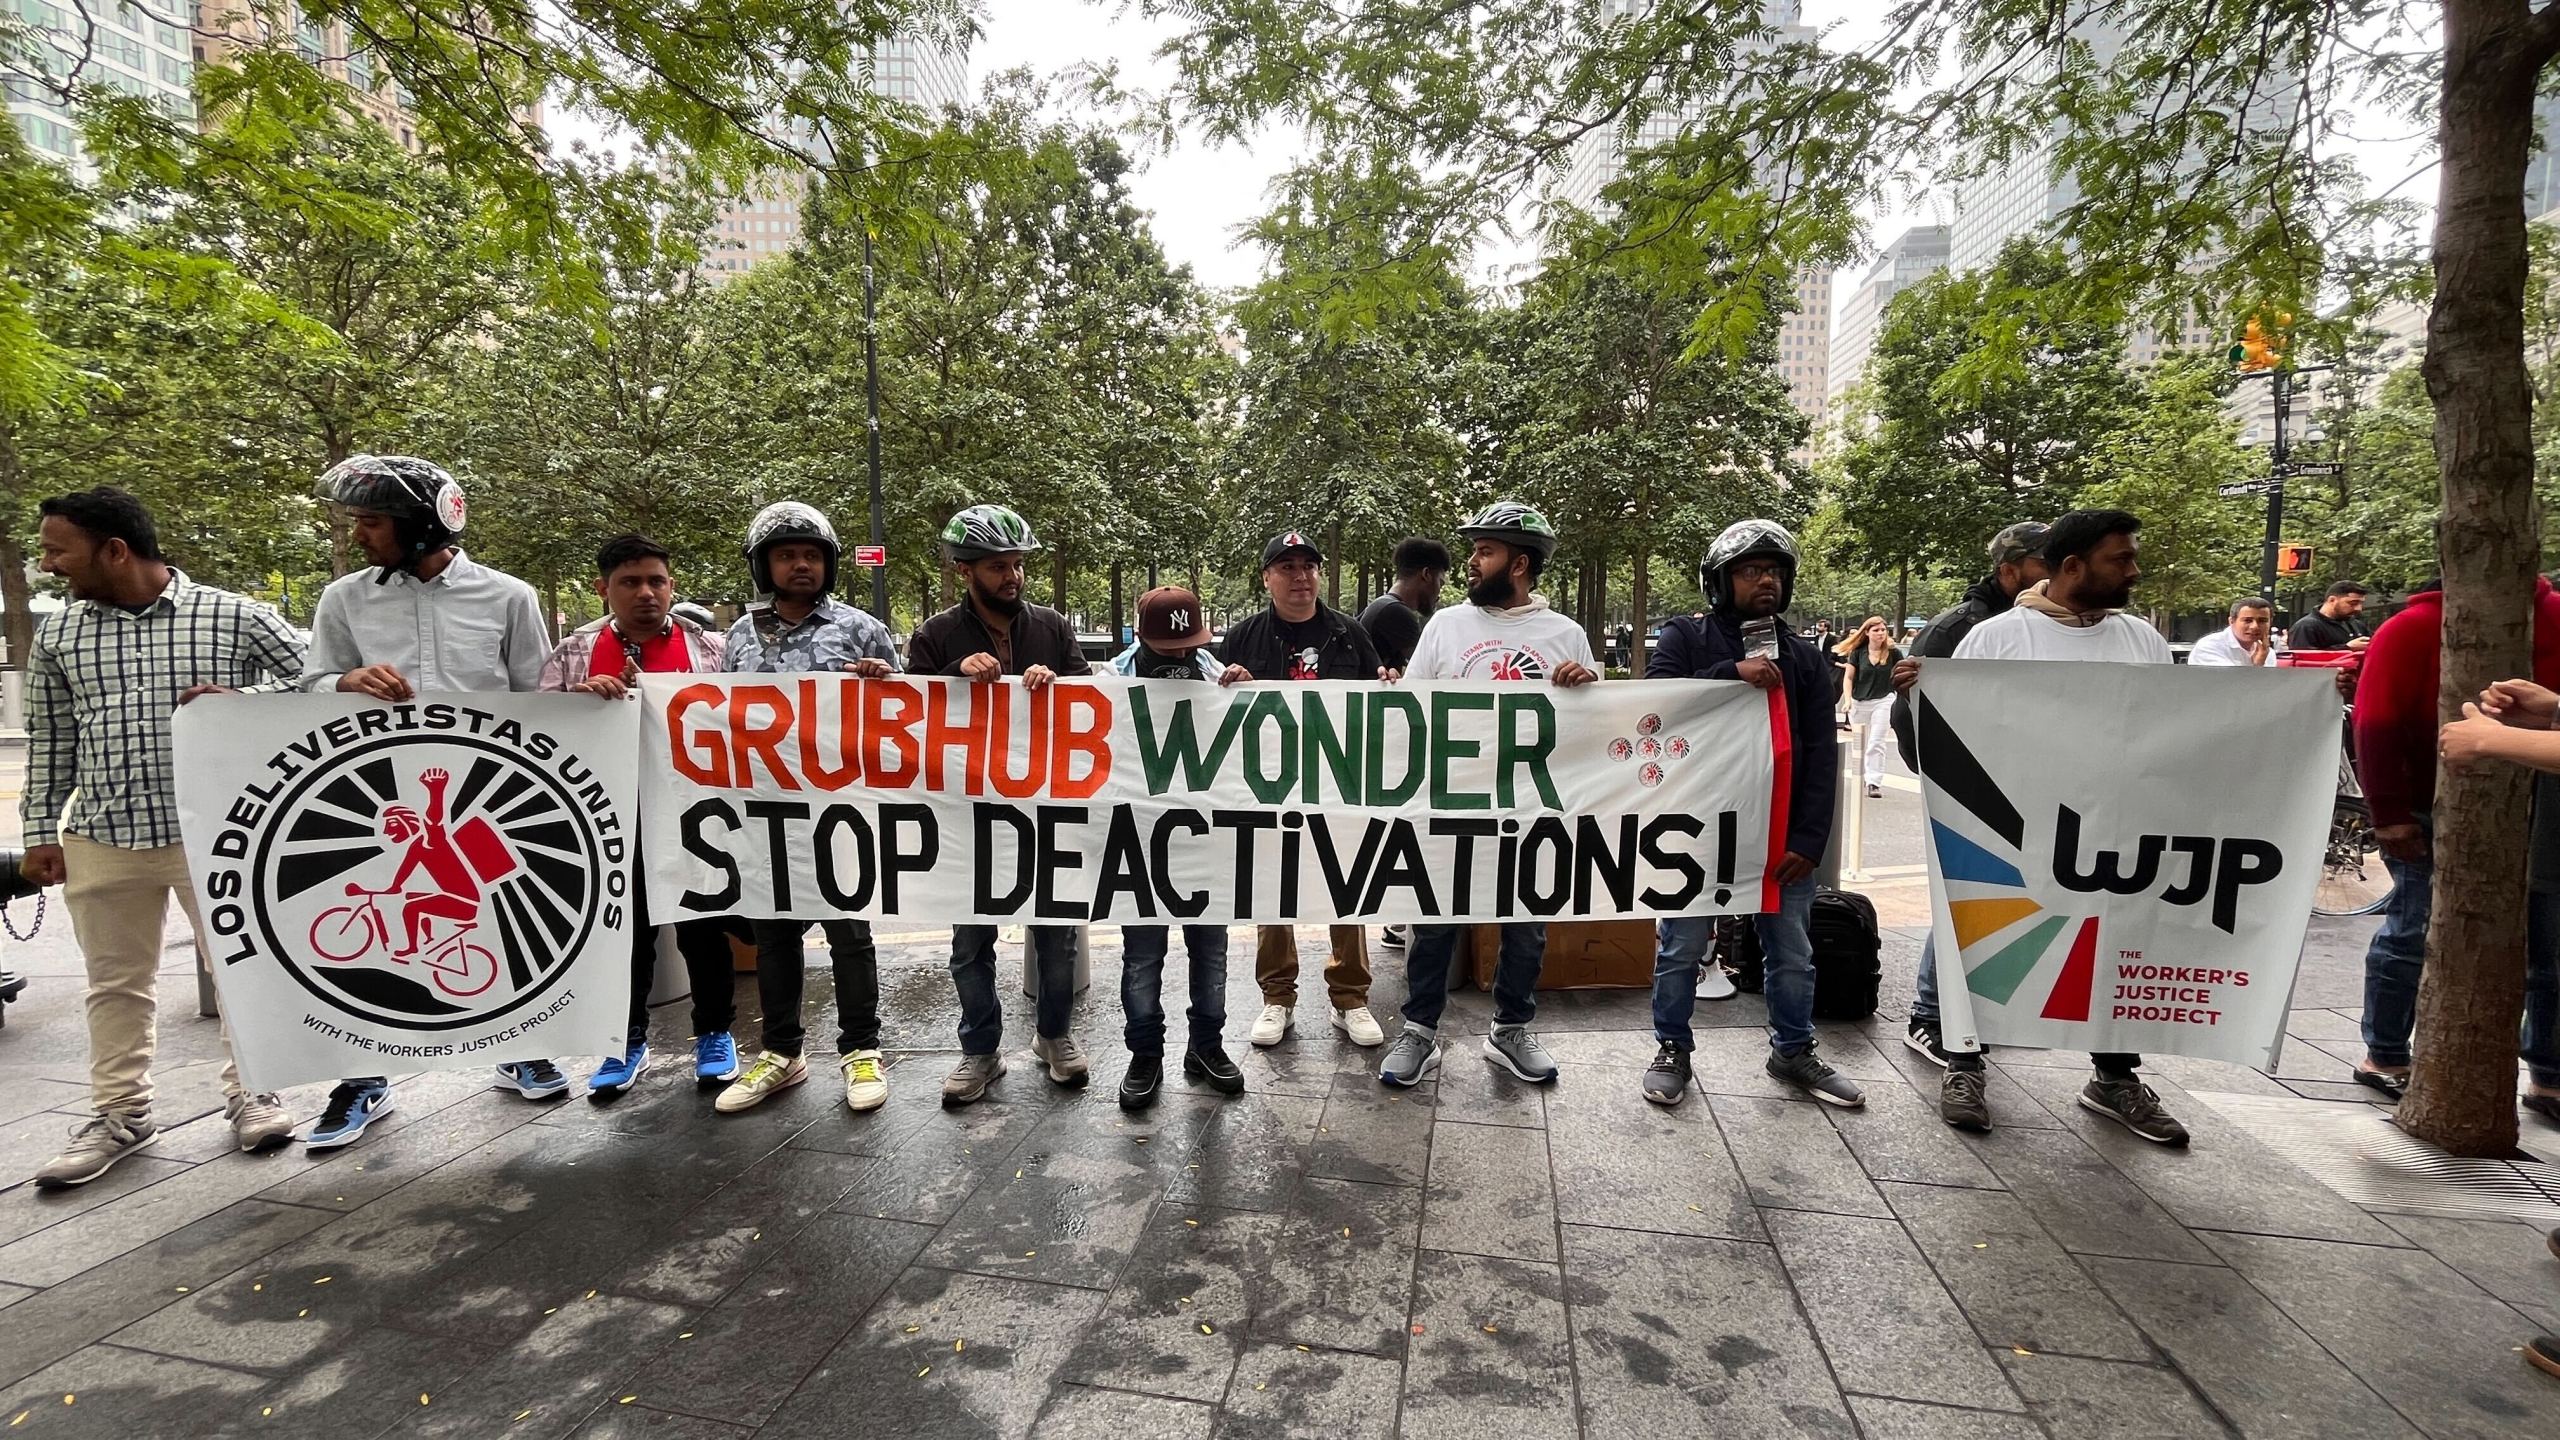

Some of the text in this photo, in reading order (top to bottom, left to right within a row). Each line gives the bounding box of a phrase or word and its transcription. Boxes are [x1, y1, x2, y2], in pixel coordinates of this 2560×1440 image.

[1169, 608, 1190, 632] NY
[1464, 643, 1484, 659] STAND
[1485, 639, 1503, 649] WITH
[1521, 644, 1549, 670] TO APOYO
[667, 679, 1564, 811] GRUBHUB WONDER
[207, 703, 626, 967] LOS DELIVERISTAS UNIDOS
[678, 797, 940, 916] STOP
[2052, 803, 2283, 935] WJP
[2119, 950, 2142, 959] THE
[2117, 964, 2249, 987] WORKER'S
[2113, 985, 2211, 1004] JUSTICE
[302, 989, 576, 1058] WITH THE WORKERS JUSTICE PROJECT
[2112, 1005, 2222, 1026] PROJECT
